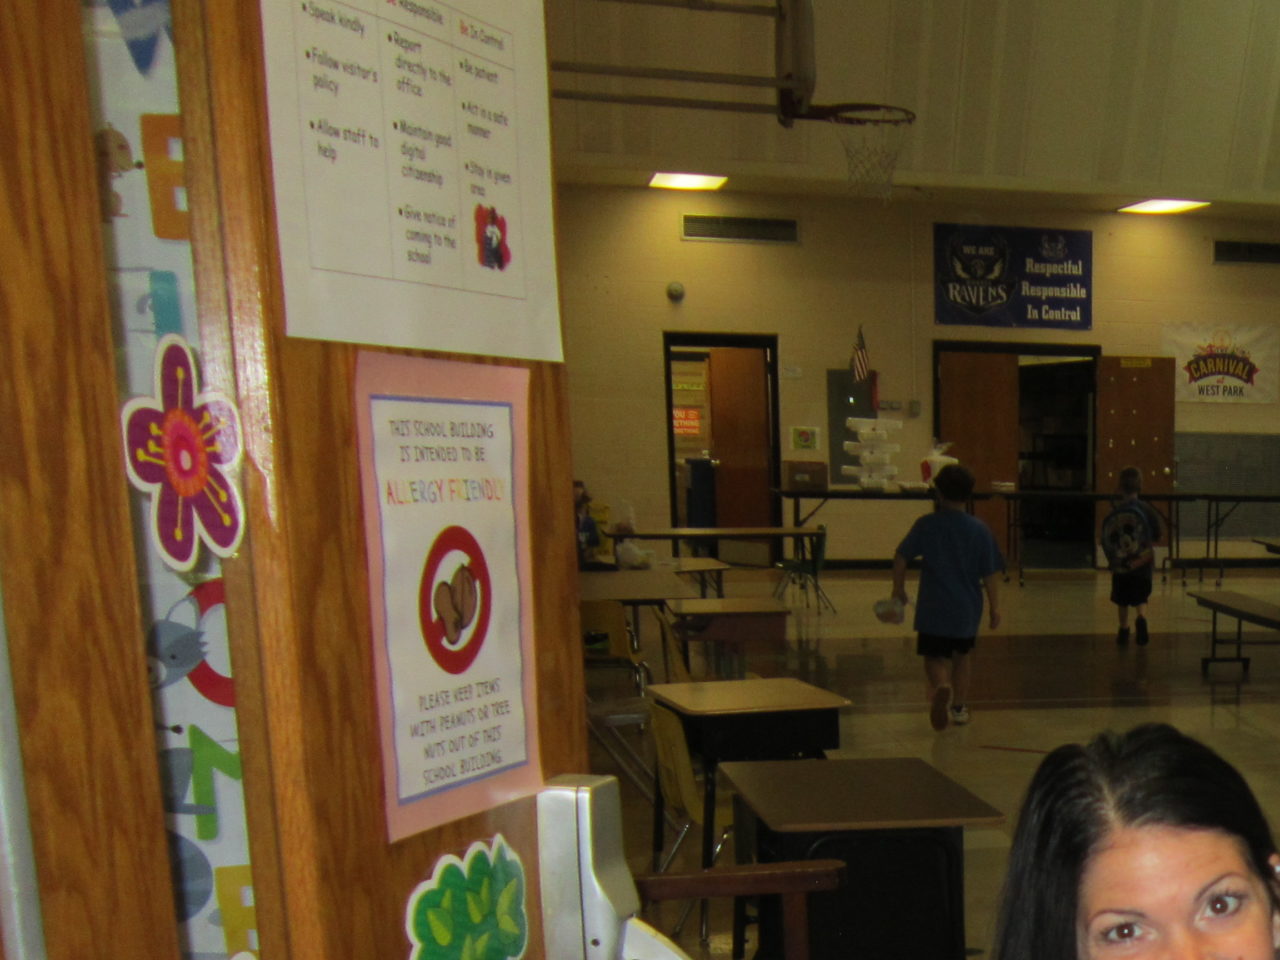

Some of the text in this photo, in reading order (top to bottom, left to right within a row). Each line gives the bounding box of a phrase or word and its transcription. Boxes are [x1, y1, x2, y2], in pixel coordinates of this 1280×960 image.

[309, 2, 365, 38] Speak kindly
[312, 47, 339, 70] Follow
[313, 74, 339, 96] policy
[397, 76, 423, 97] office
[317, 118, 379, 148] Allow staff to
[318, 141, 337, 164] help
[404, 204, 422, 221] Give
[434, 233, 443, 246] to
[963, 245, 995, 256] WE ARE
[1025, 258, 1083, 277] Respectful
[948, 282, 1007, 306] RAVENS
[1021, 281, 1087, 300] Responsible
[1027, 304, 1081, 321] In Control
[1190, 357, 1250, 379] CARNIVAL
[1198, 384, 1244, 397] WEST PARK
[388, 420, 494, 439] THIS SCHOOL BUILDING
[399, 445, 486, 462] IS INTENDED TO BE
[386, 479, 444, 505] ALLERGY
[419, 677, 500, 712] PLEASE KEEP ITEMS
[409, 700, 511, 738] WITH PEANUTS OR TREE
[423, 725, 502, 760] NUTS OUT OF THIS
[423, 750, 502, 785] SCHOOL BUILDING
